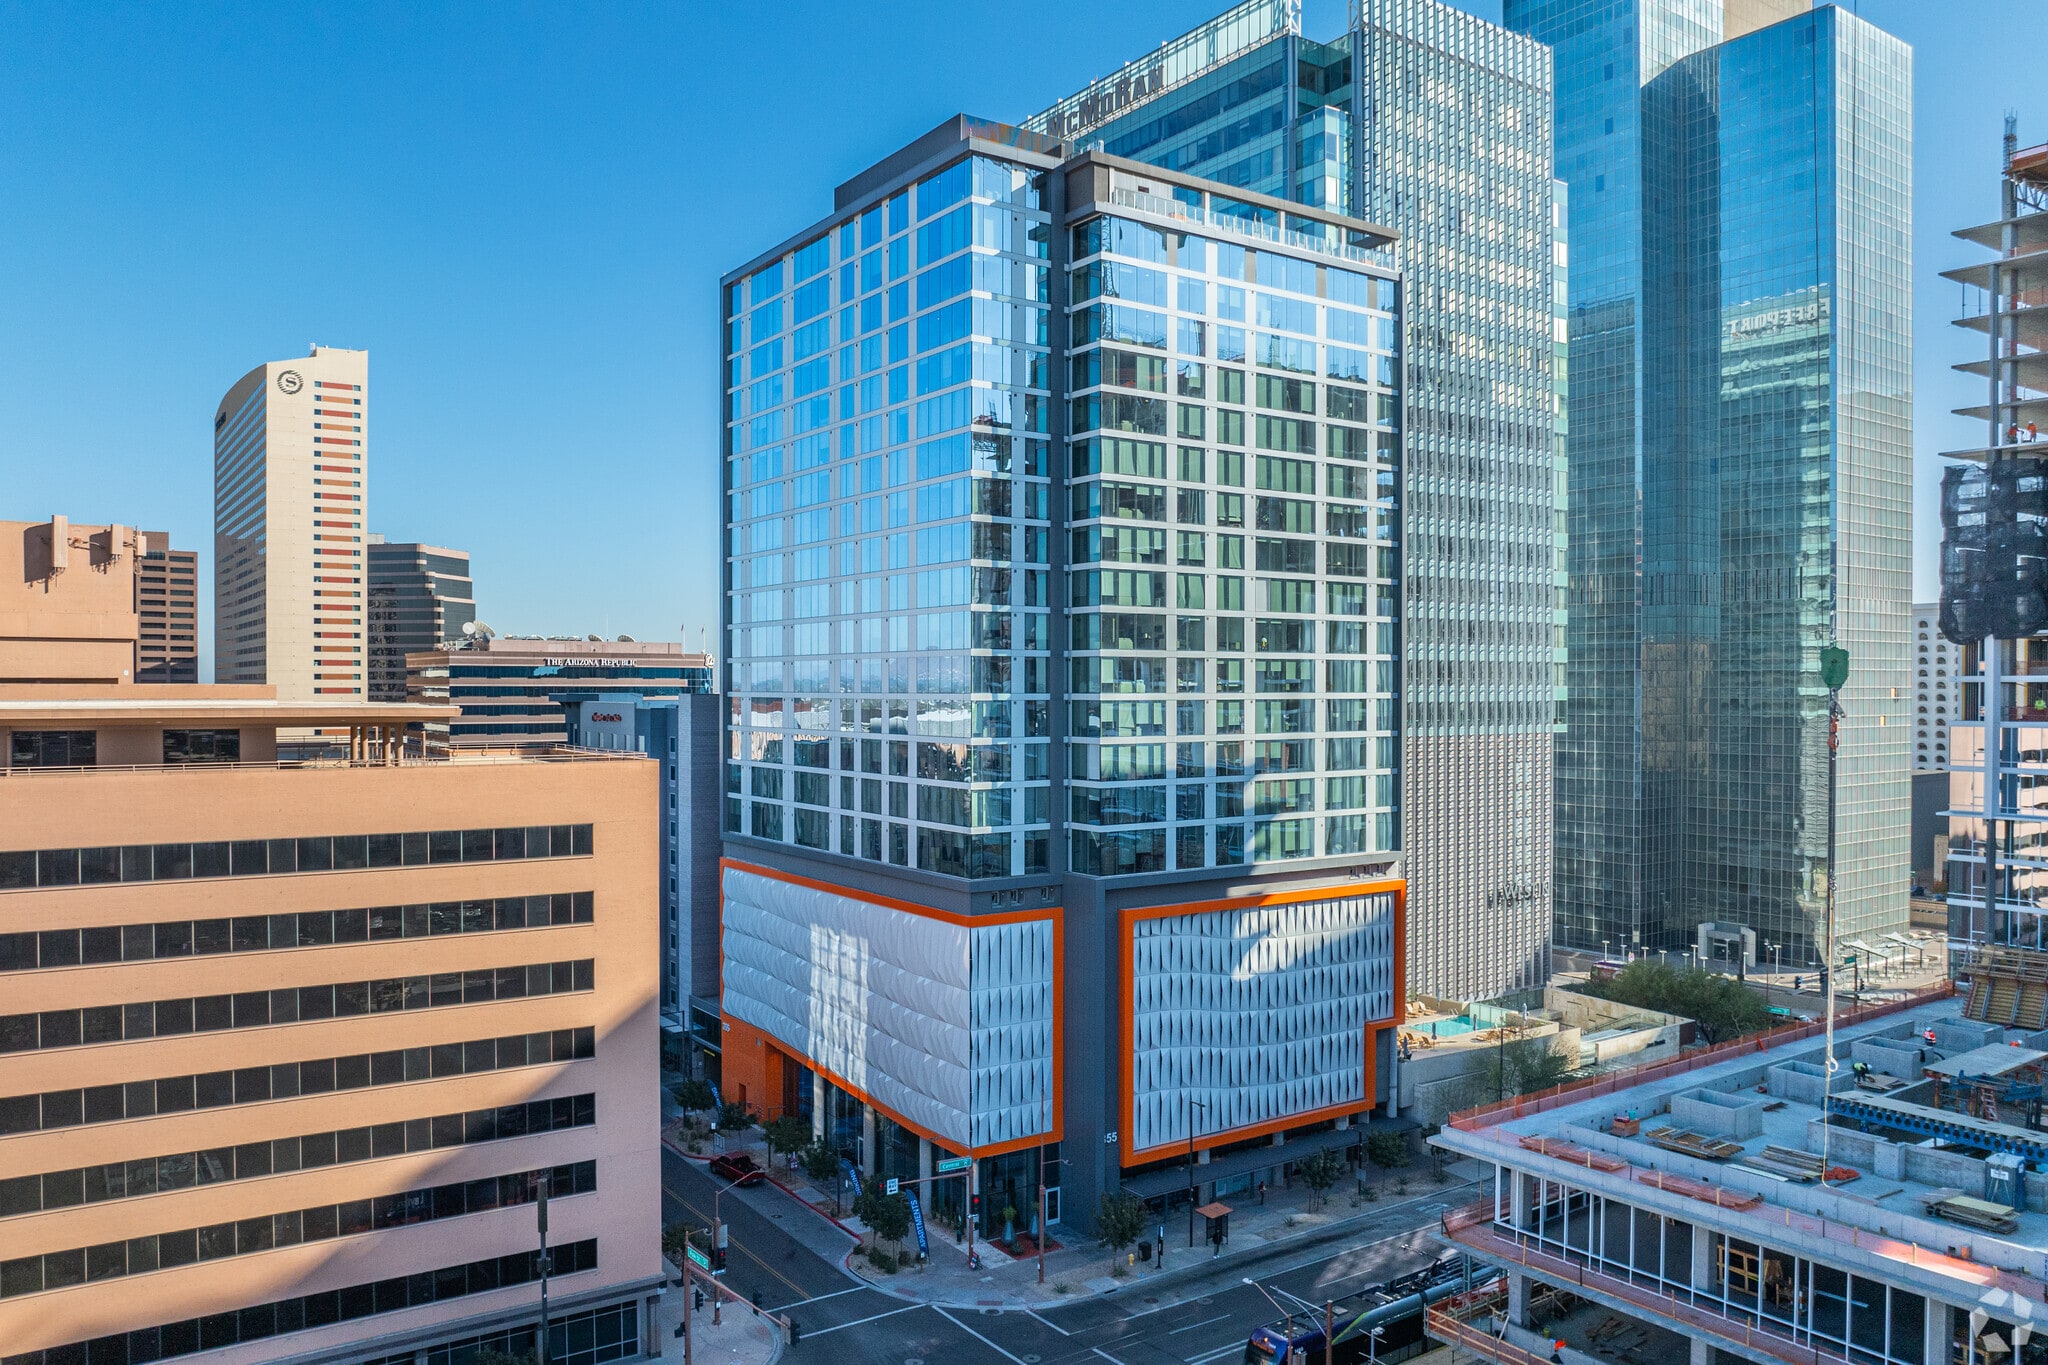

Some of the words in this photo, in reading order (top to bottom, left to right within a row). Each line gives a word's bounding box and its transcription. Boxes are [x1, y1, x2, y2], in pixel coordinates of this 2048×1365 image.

[546, 657, 563, 666] THE
[564, 657, 600, 667] ARIZONA
[601, 657, 638, 667] REPUBLIC
[910, 1199, 927, 1248] APARTMENTS
